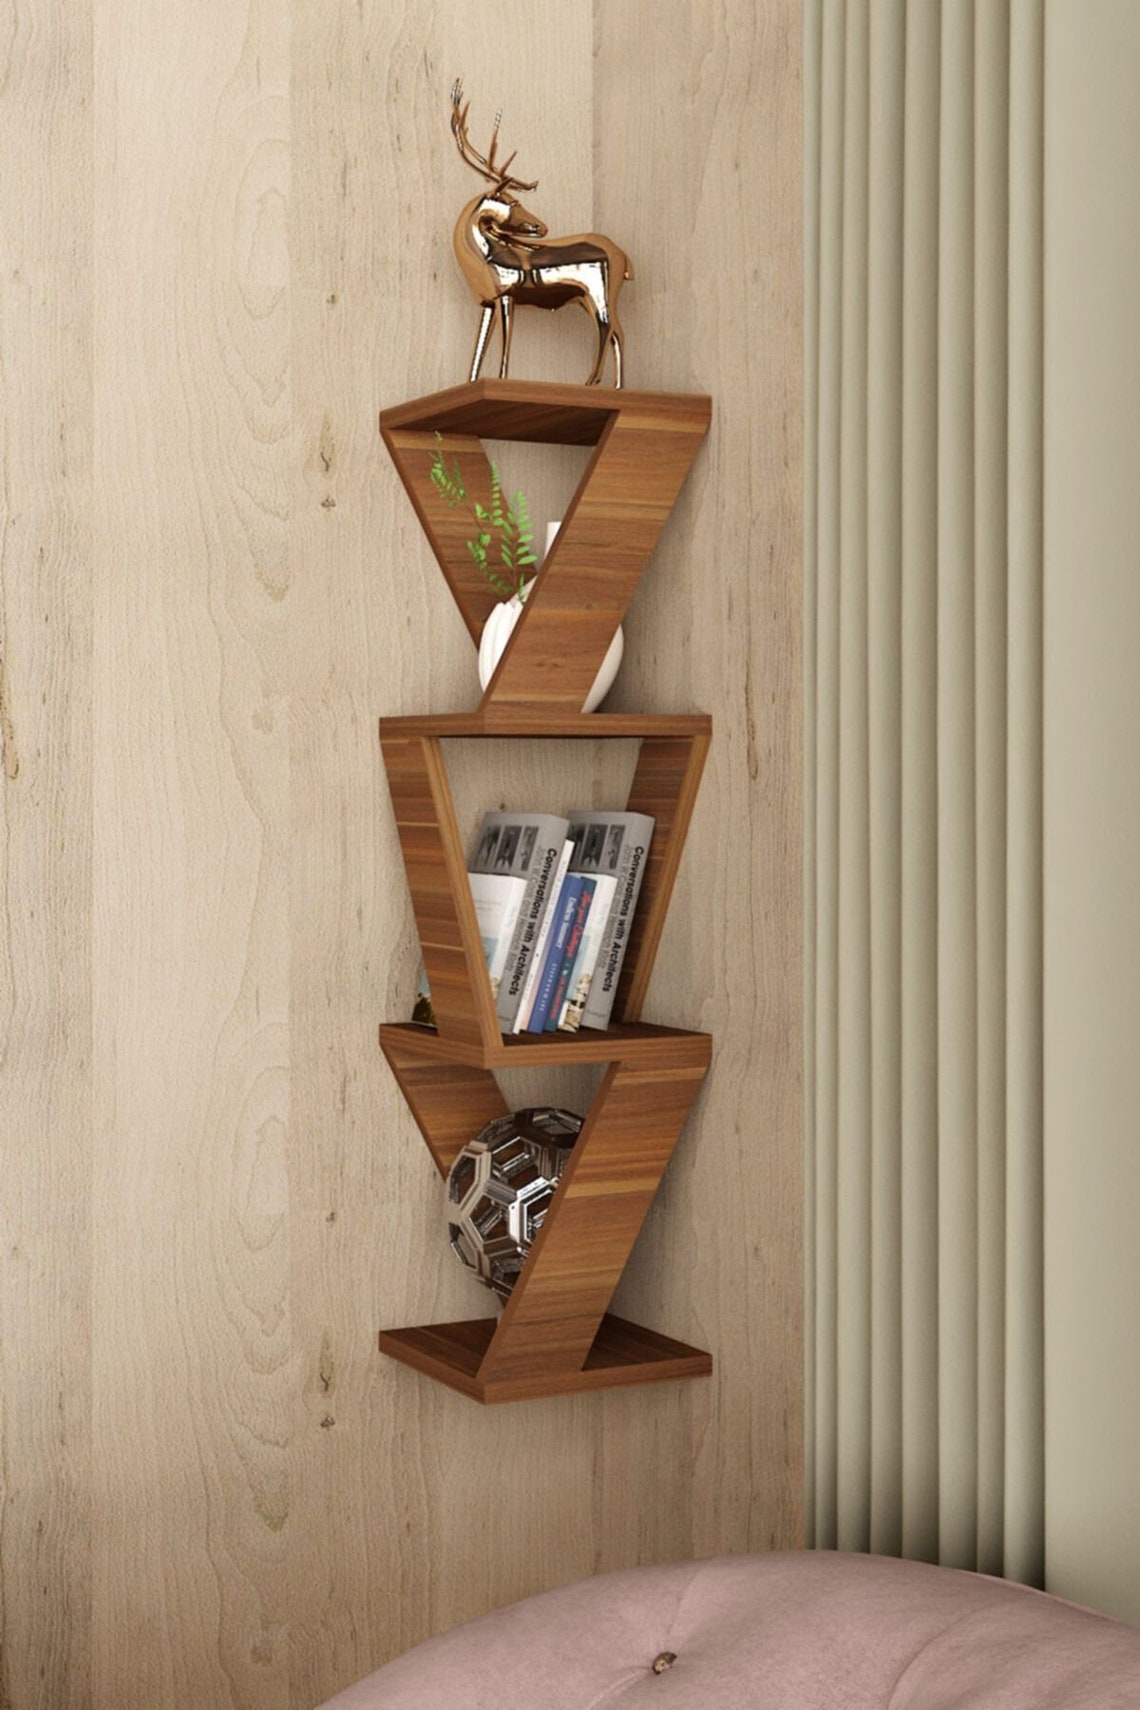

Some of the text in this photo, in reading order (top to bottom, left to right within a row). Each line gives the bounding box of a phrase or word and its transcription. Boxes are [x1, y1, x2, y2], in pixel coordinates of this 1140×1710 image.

[529, 848, 557, 919] Conversations
[523, 921, 536, 942] with
[602, 846, 644, 991] Conversations with Architects
[508, 945, 530, 996] Architects
